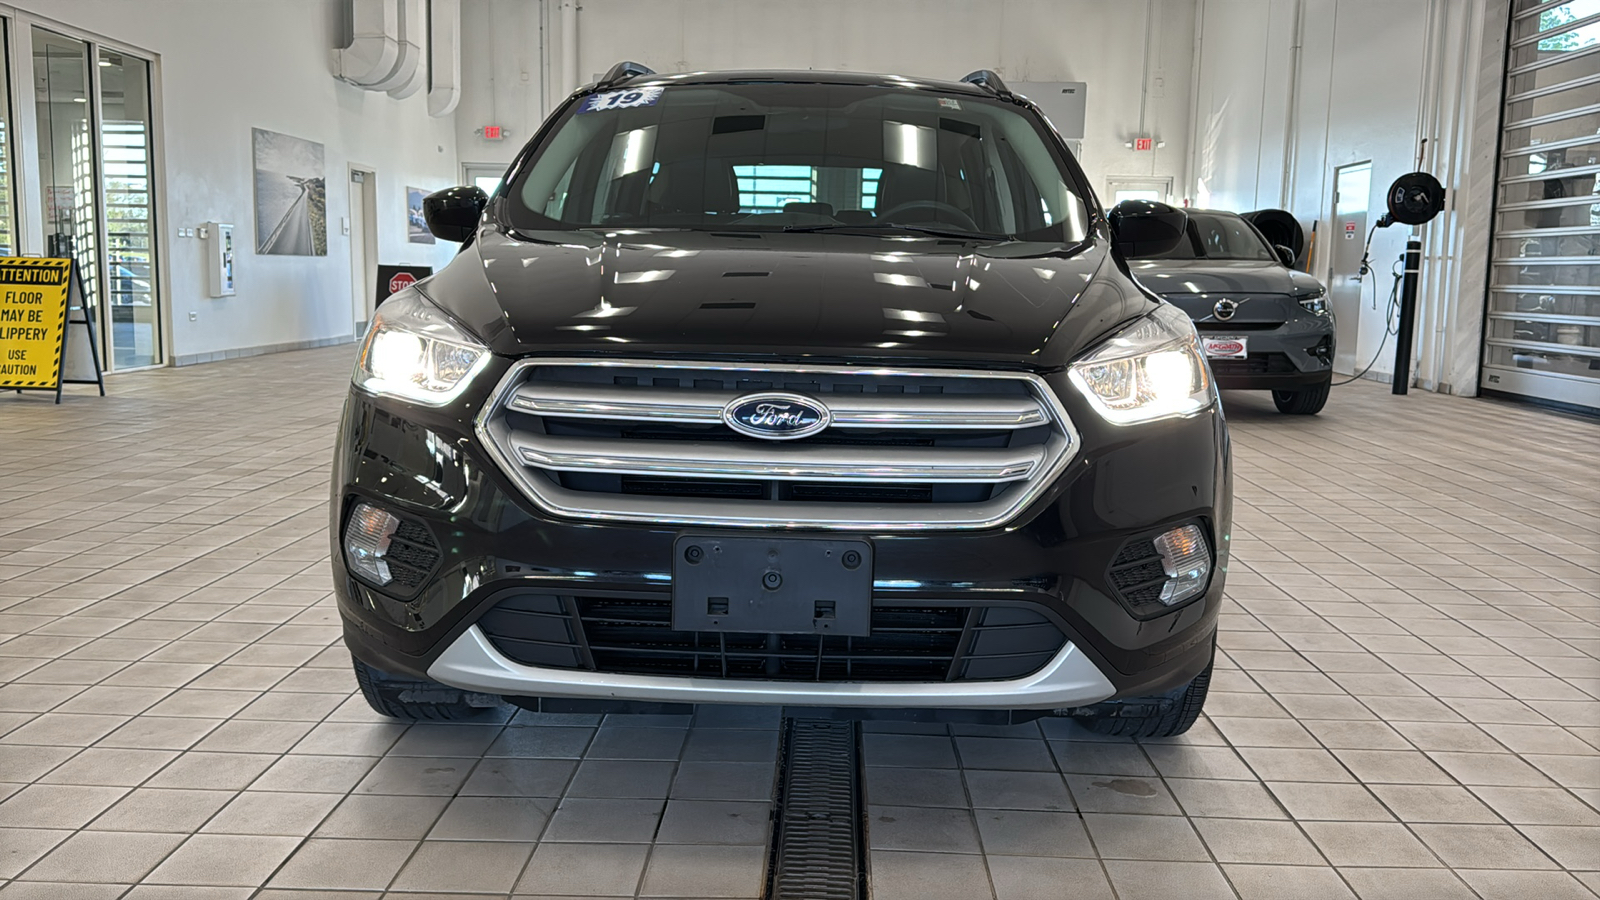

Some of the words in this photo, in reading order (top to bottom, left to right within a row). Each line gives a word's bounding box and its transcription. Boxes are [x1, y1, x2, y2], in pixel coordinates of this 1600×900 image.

[607, 92, 643, 106] 19
[1137, 138, 1152, 150] EXIT
[0, 268, 60, 283] TTENTION
[5, 291, 43, 305] FLOOR
[0, 309, 25, 322] MAY
[27, 310, 43, 323] BE
[0, 326, 49, 341] LIPPERY
[8, 349, 27, 360] USE
[0, 364, 37, 375] AUTION
[750, 403, 804, 426] Ford
